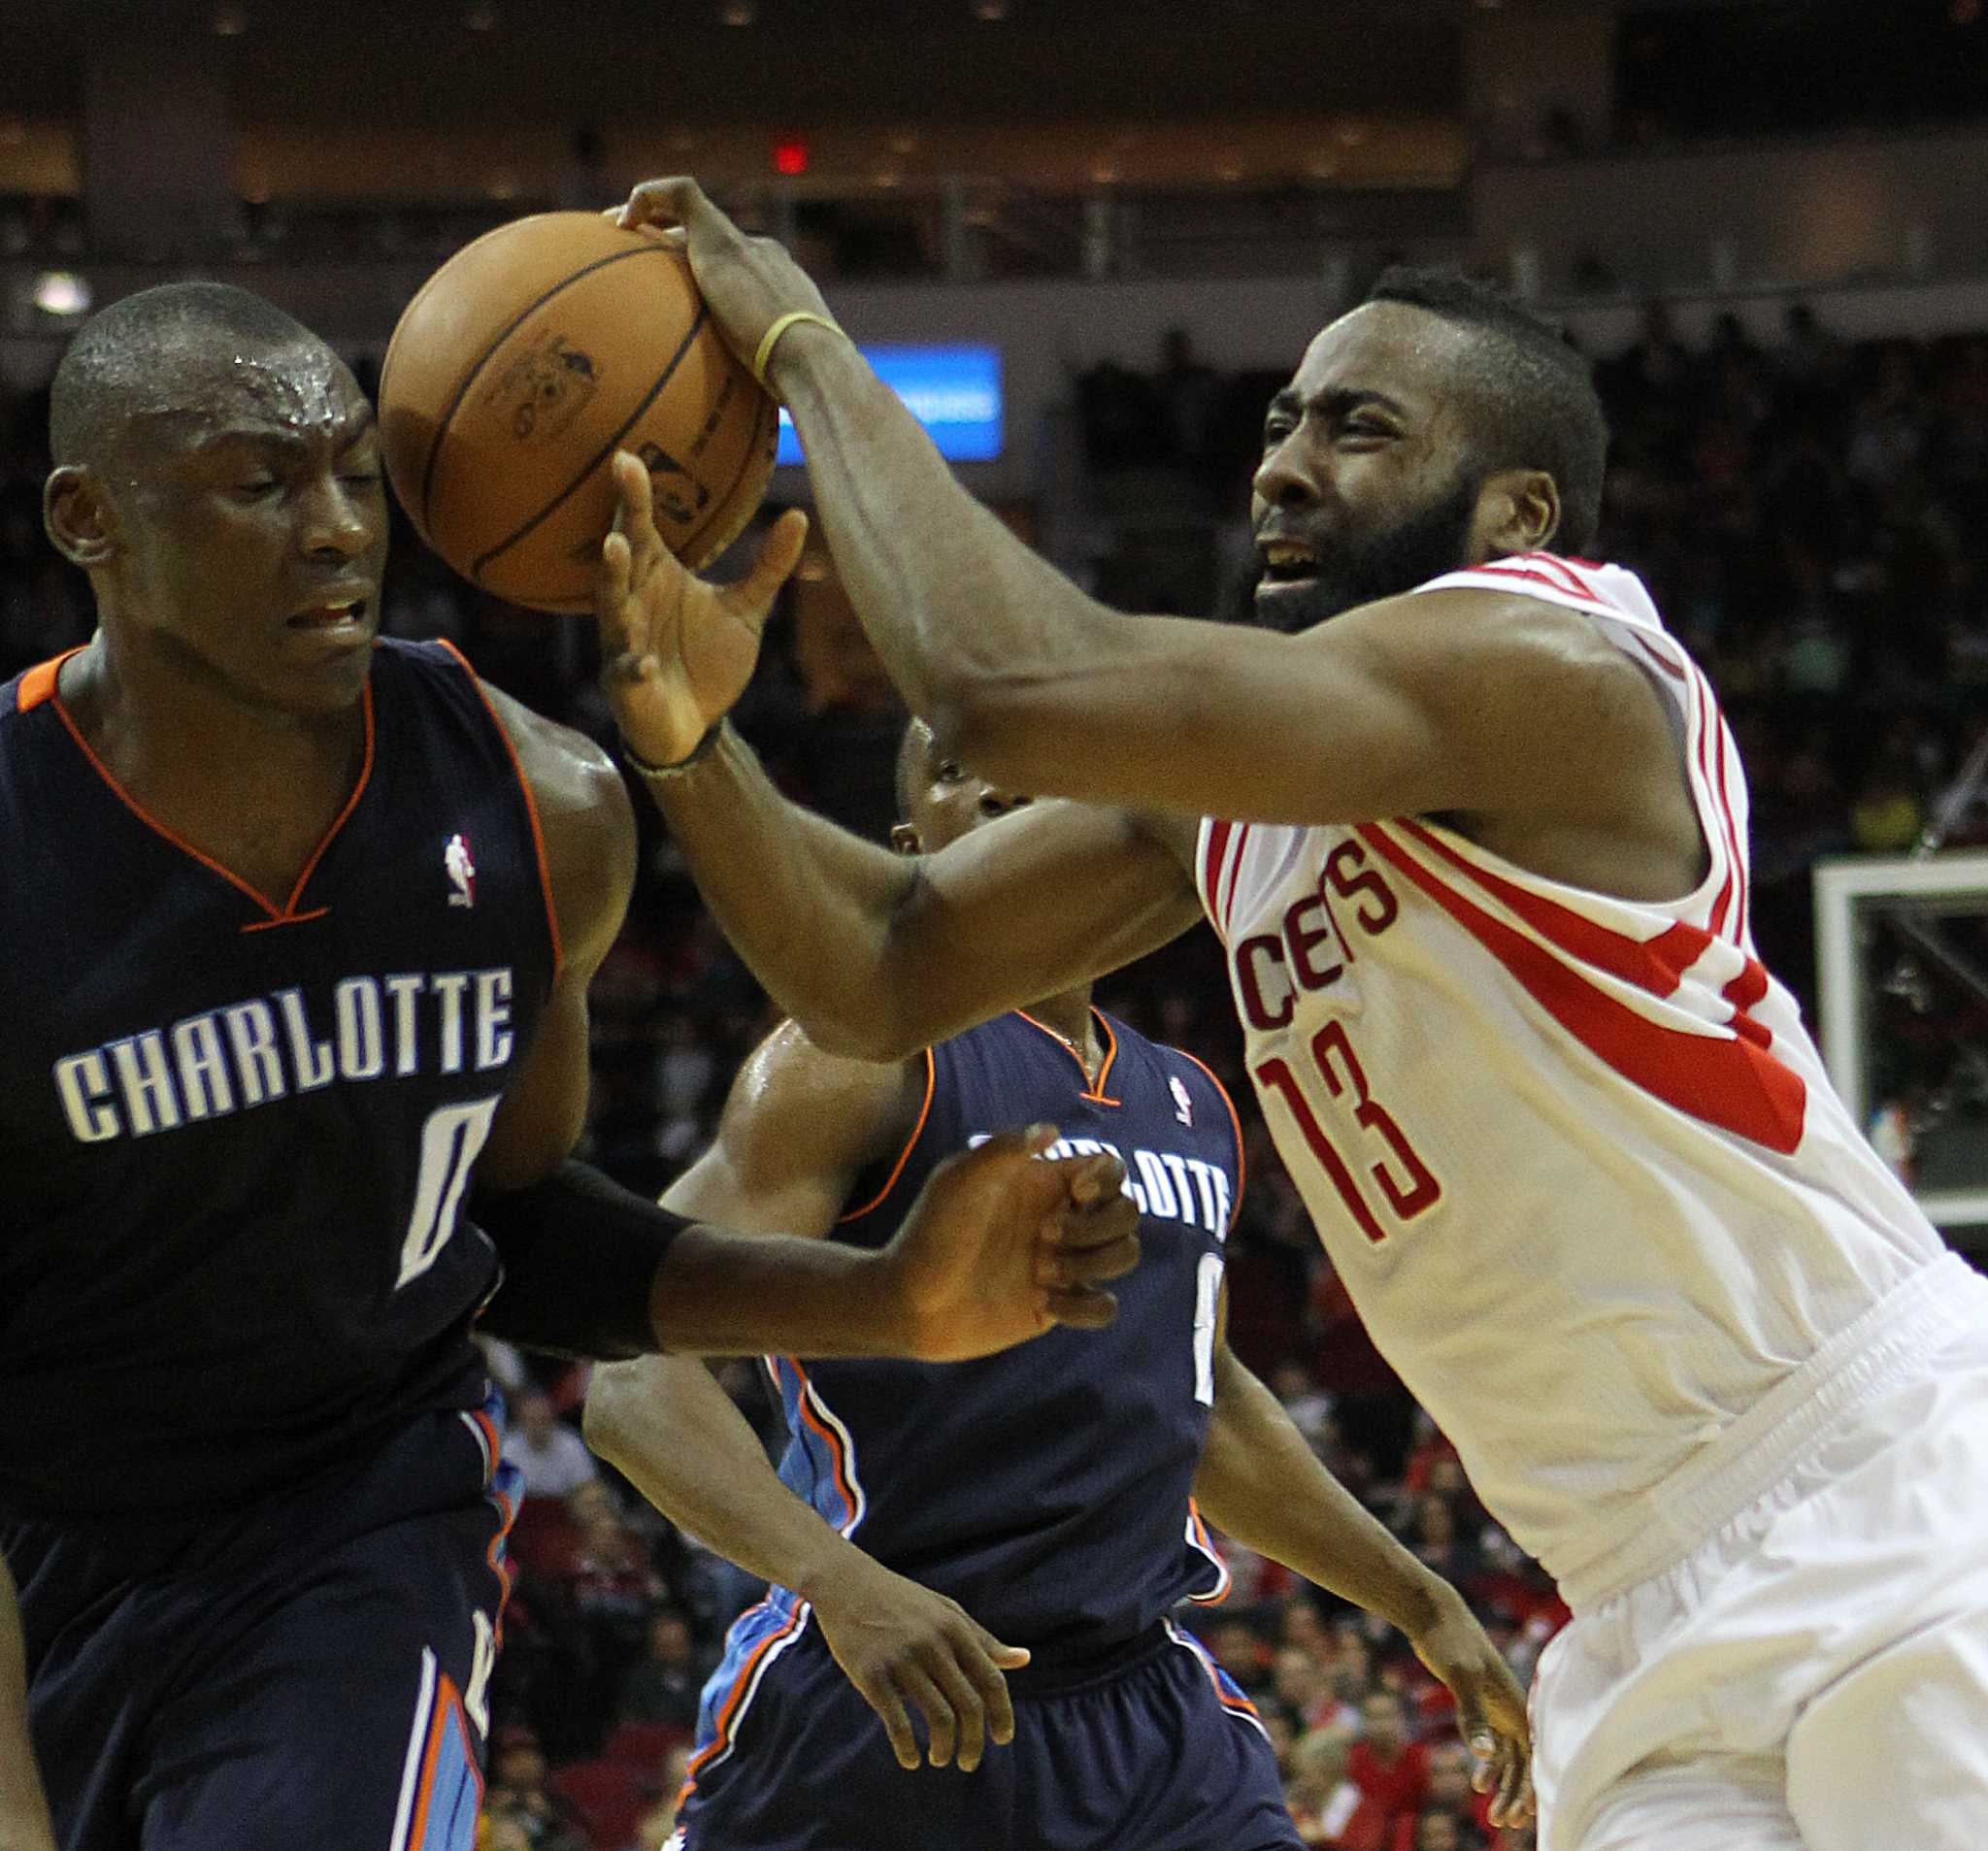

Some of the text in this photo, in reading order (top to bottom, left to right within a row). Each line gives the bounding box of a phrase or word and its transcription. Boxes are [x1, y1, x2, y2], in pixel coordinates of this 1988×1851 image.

[52, 967, 514, 1143] CHARLOTTE
[1256, 1019, 1441, 1243] 13
[393, 1093, 503, 1290] 0
